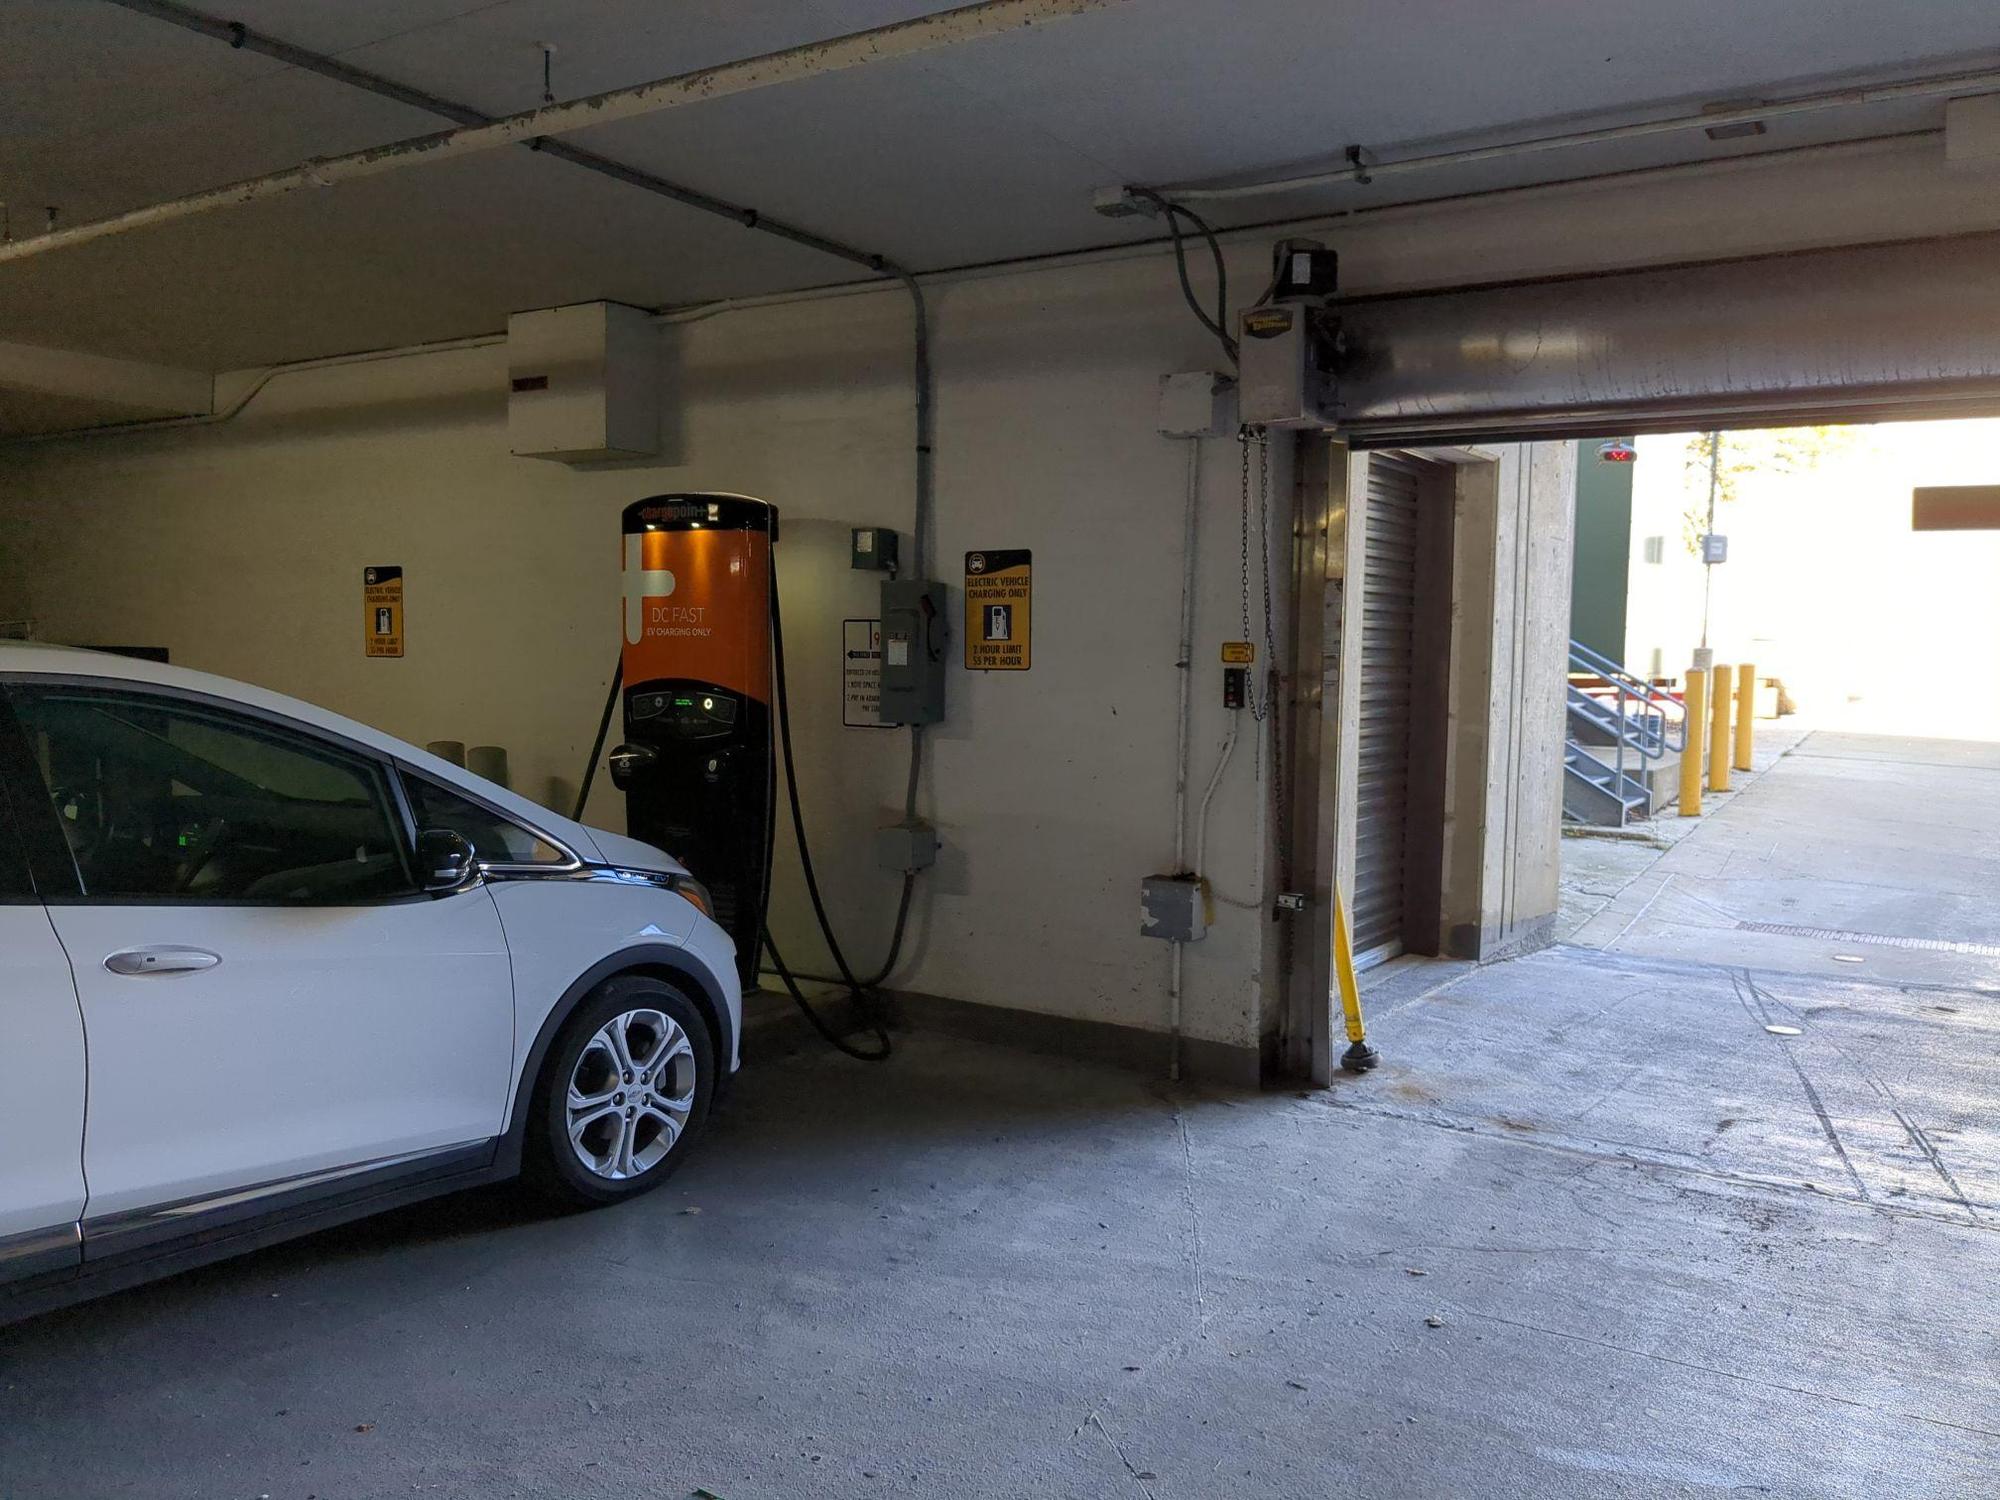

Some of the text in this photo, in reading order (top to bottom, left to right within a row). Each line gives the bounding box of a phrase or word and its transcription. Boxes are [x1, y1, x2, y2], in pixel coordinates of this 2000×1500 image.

[967, 576, 1029, 587] ELECTRIC VEHICLE
[968, 588, 1027, 599] CHARGING ONLY
[652, 607, 705, 623] DC FAST
[647, 627, 712, 637] EV CHARGING ONLY
[973, 644, 1022, 654] 2 HOUR LIMIT
[983, 656, 997, 665] PER
[1000, 656, 1022, 665] HOUR
